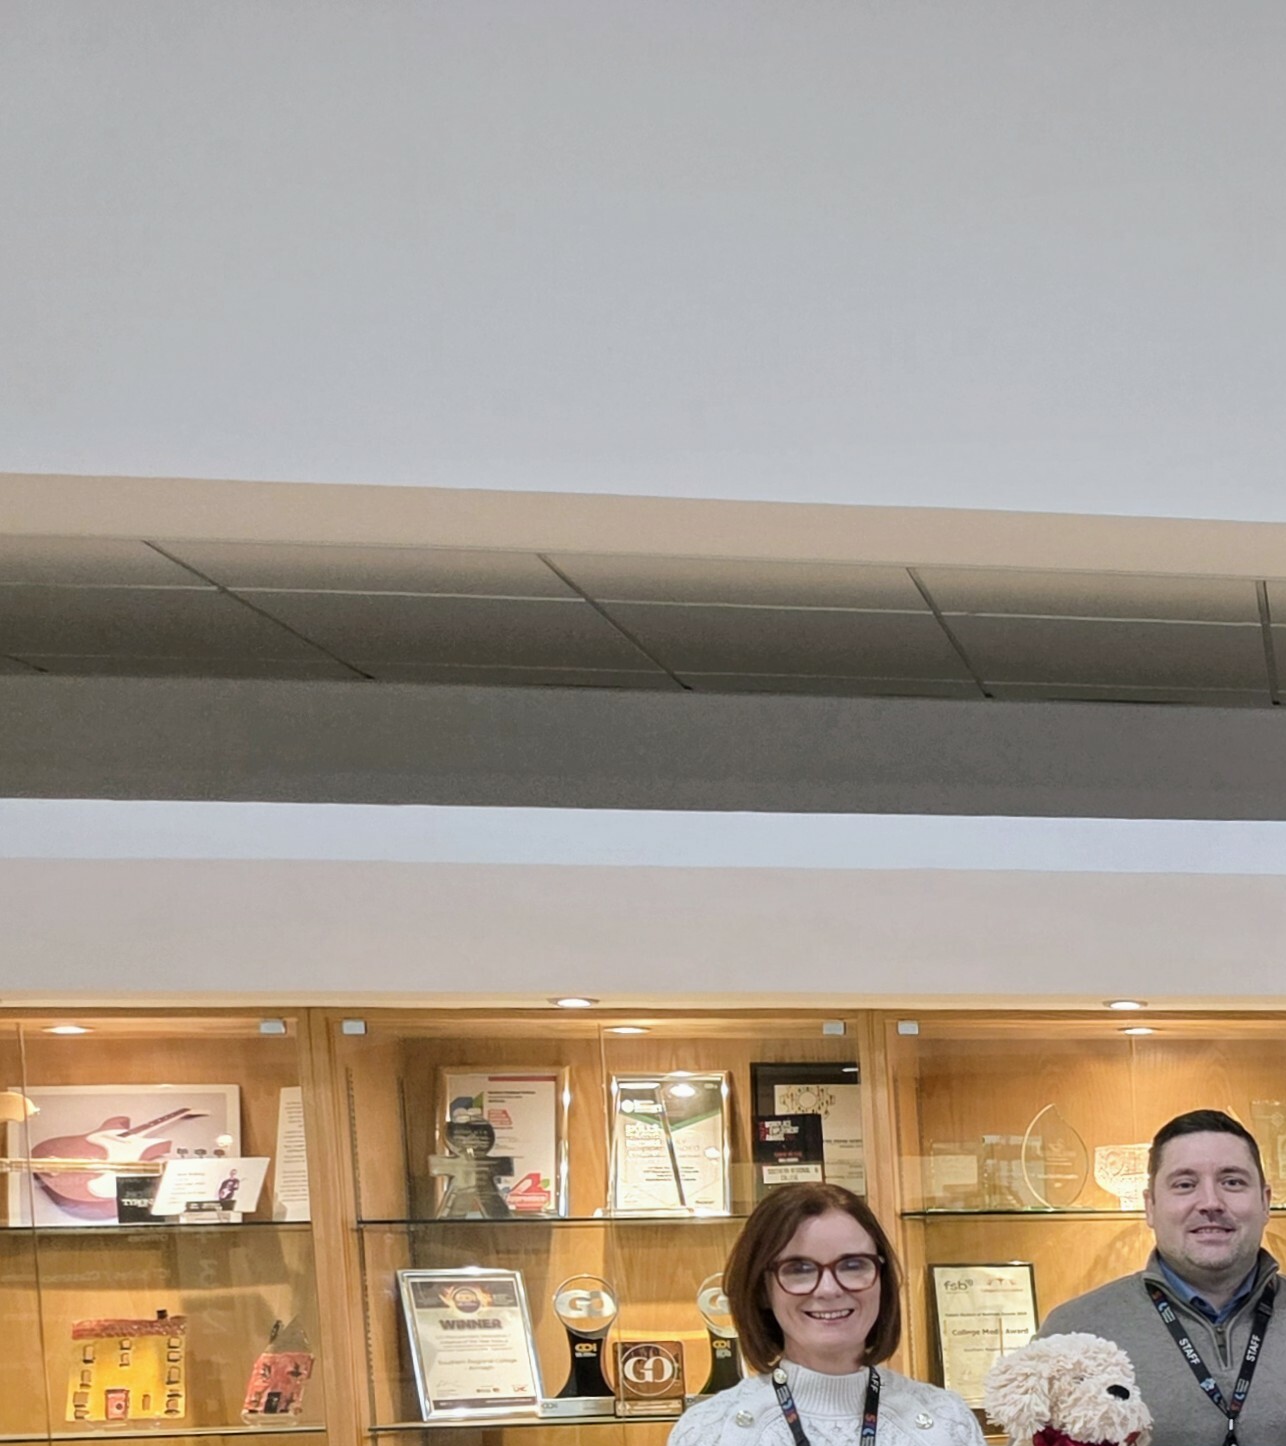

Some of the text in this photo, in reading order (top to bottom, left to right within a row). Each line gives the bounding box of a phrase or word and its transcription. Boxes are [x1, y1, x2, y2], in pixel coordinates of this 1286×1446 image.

[440, 1318, 503, 1331] WINNER
[1179, 1338, 1201, 1366] STAFF
[1246, 1335, 1261, 1362] STAFF
